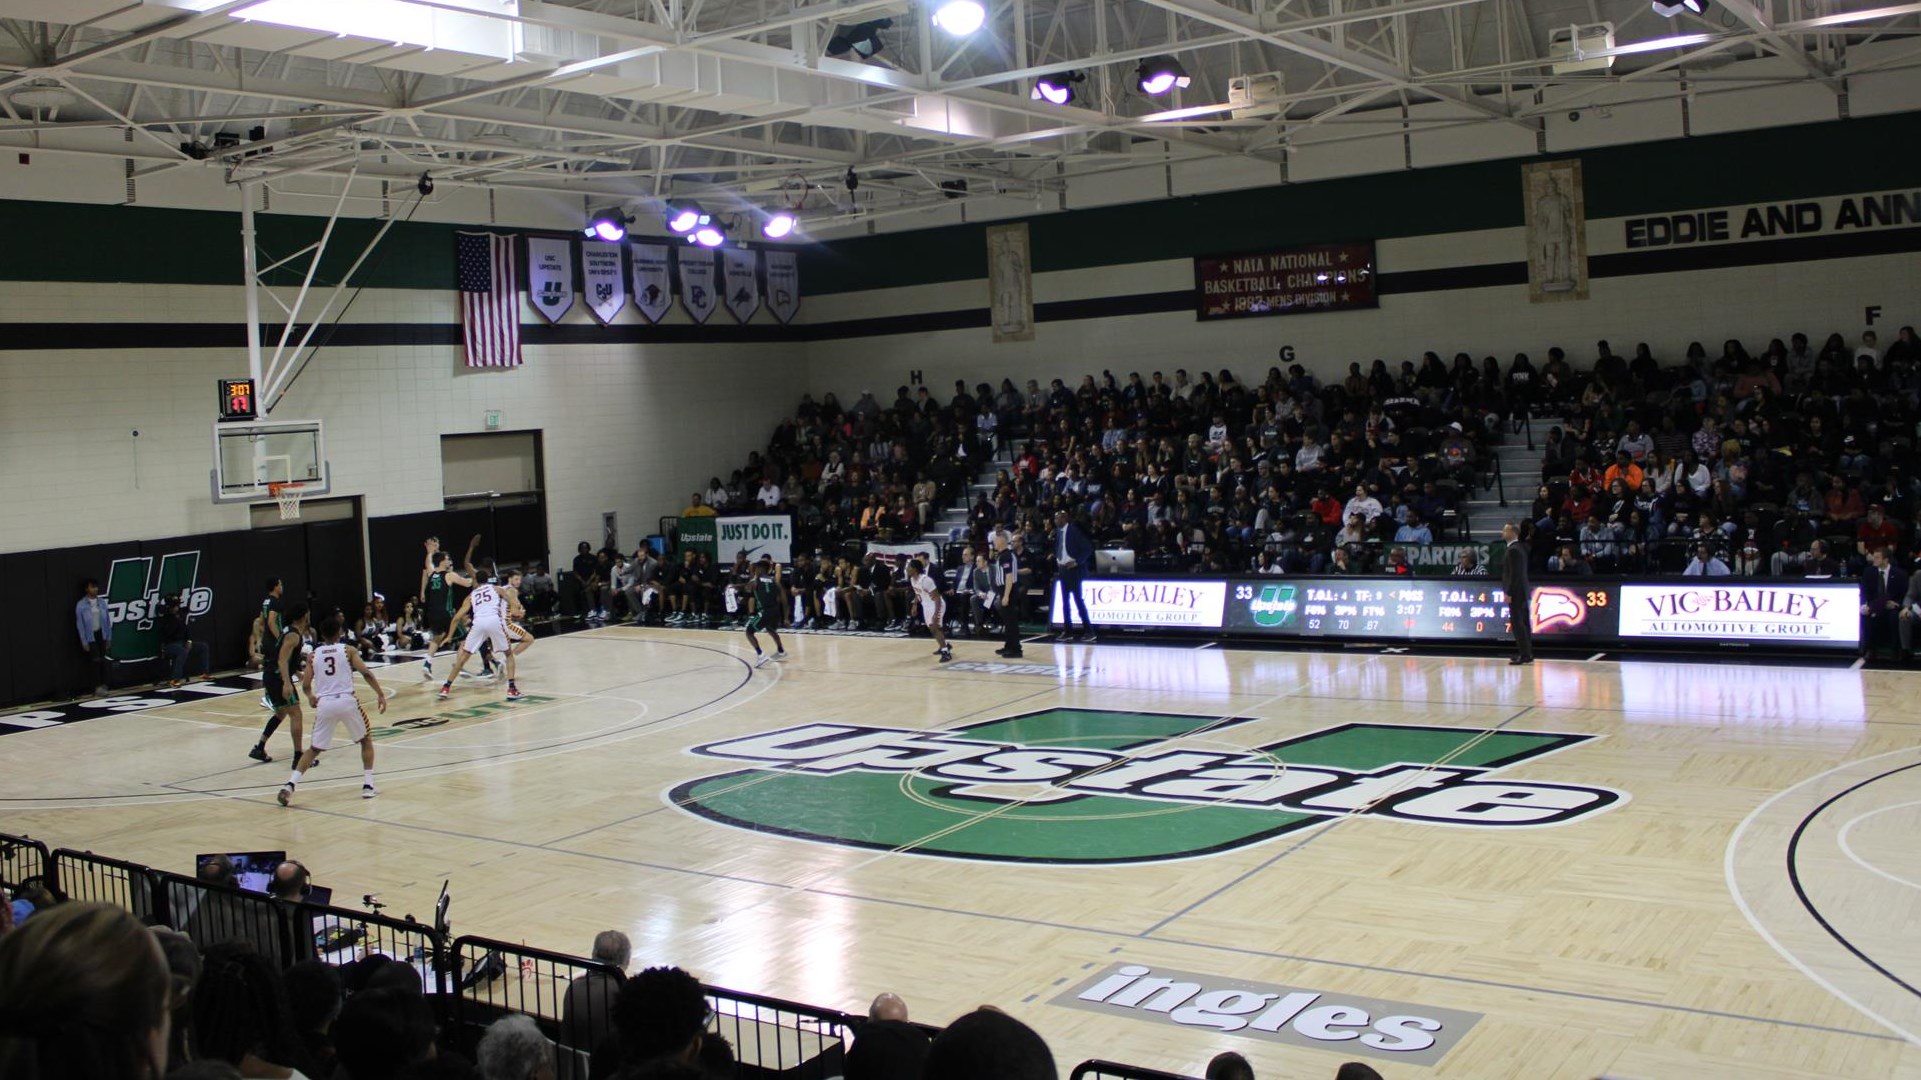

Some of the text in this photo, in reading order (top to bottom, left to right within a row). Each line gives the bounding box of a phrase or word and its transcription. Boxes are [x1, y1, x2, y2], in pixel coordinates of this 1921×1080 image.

[1625, 211, 1729, 249] EDDIE
[1740, 202, 1822, 238] AND
[1233, 251, 1333, 274] NAIA NATIONAL
[1204, 268, 1368, 295] BASKETBALL CHAMPIONS
[1865, 305, 1882, 325] F
[1279, 345, 1295, 363] G
[910, 370, 923, 385] H
[721, 523, 789, 540] JUST DO IT.
[474, 589, 492, 606] 25
[1122, 584, 1204, 609] BAILEY
[1235, 586, 1253, 600] 33
[1478, 593, 1486, 602] 4
[1586, 591, 1607, 607] 33
[1396, 604, 1422, 616] 3:07
[1646, 590, 1700, 618] VIC
[1713, 589, 1830, 620] BAILEY
[1156, 612, 1199, 622] GROUP
[1308, 620, 1320, 630] 52
[1338, 620, 1349, 630] 70
[1441, 622, 1455, 632] 44
[1648, 621, 1824, 635] AUTOMOTIVE GROUP
[323, 656, 336, 676] 3
[691, 722, 1632, 830] Upstate
[1077, 964, 1444, 1052] ingles
